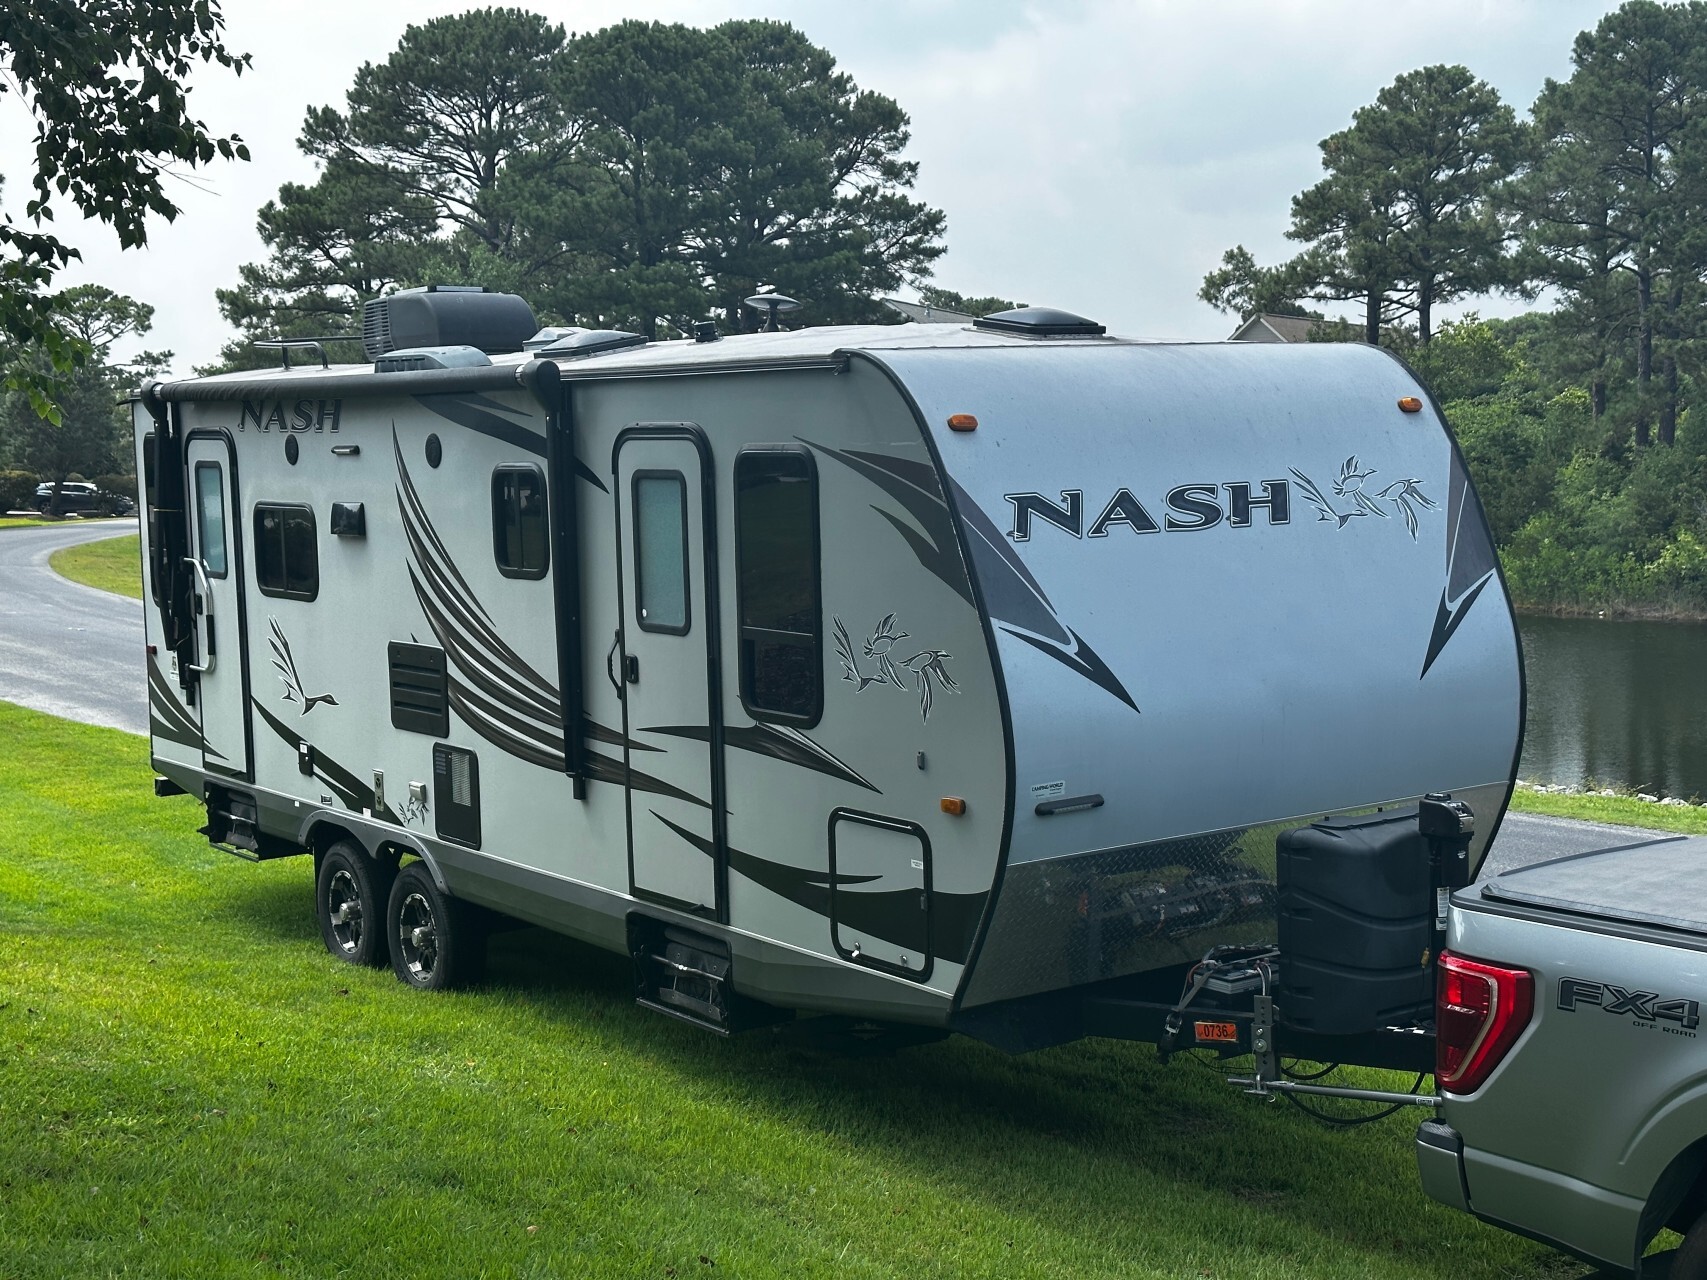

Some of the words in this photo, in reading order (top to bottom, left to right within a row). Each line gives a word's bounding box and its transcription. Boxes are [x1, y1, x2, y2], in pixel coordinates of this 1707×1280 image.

[238, 399, 341, 433] NASH
[1003, 479, 1291, 543] NASH
[1557, 976, 1699, 1030] FX4
[1203, 1024, 1228, 1038] 0736
[1632, 1020, 1658, 1030] OFF
[1662, 1026, 1697, 1039] ROAD
